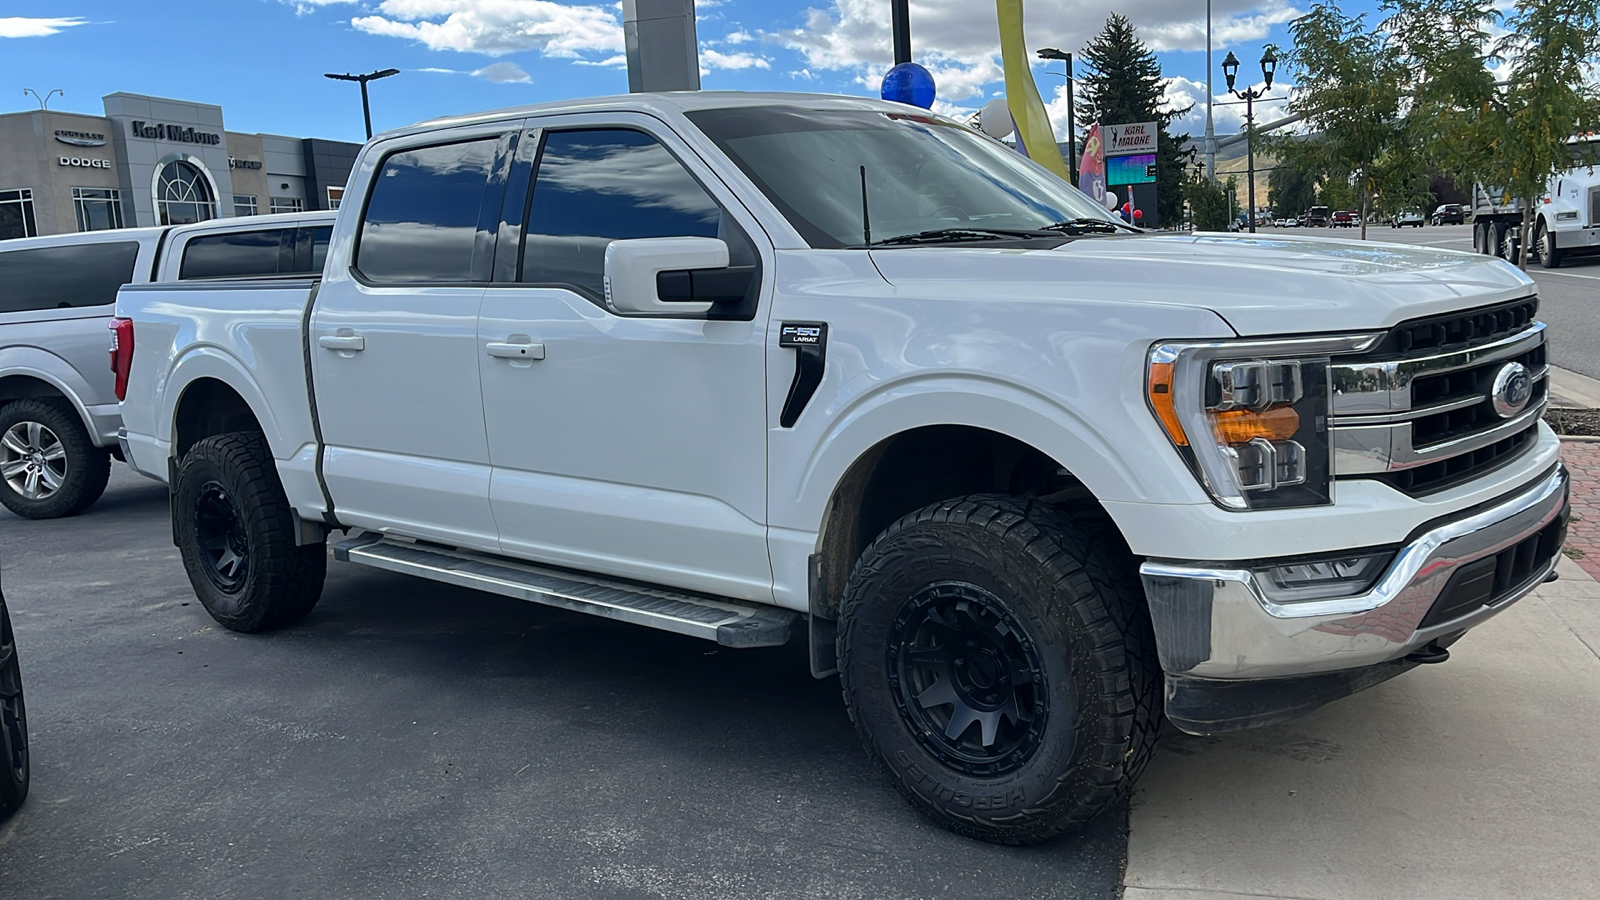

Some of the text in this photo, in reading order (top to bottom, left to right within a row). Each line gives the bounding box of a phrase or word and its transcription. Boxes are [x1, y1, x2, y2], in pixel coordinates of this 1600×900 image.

[132, 120, 220, 146] Karl Malone
[1124, 125, 1146, 135] KARL
[1118, 135, 1151, 147] MALONE
[59, 156, 111, 169] DODGE
[782, 326, 821, 337] F-150
